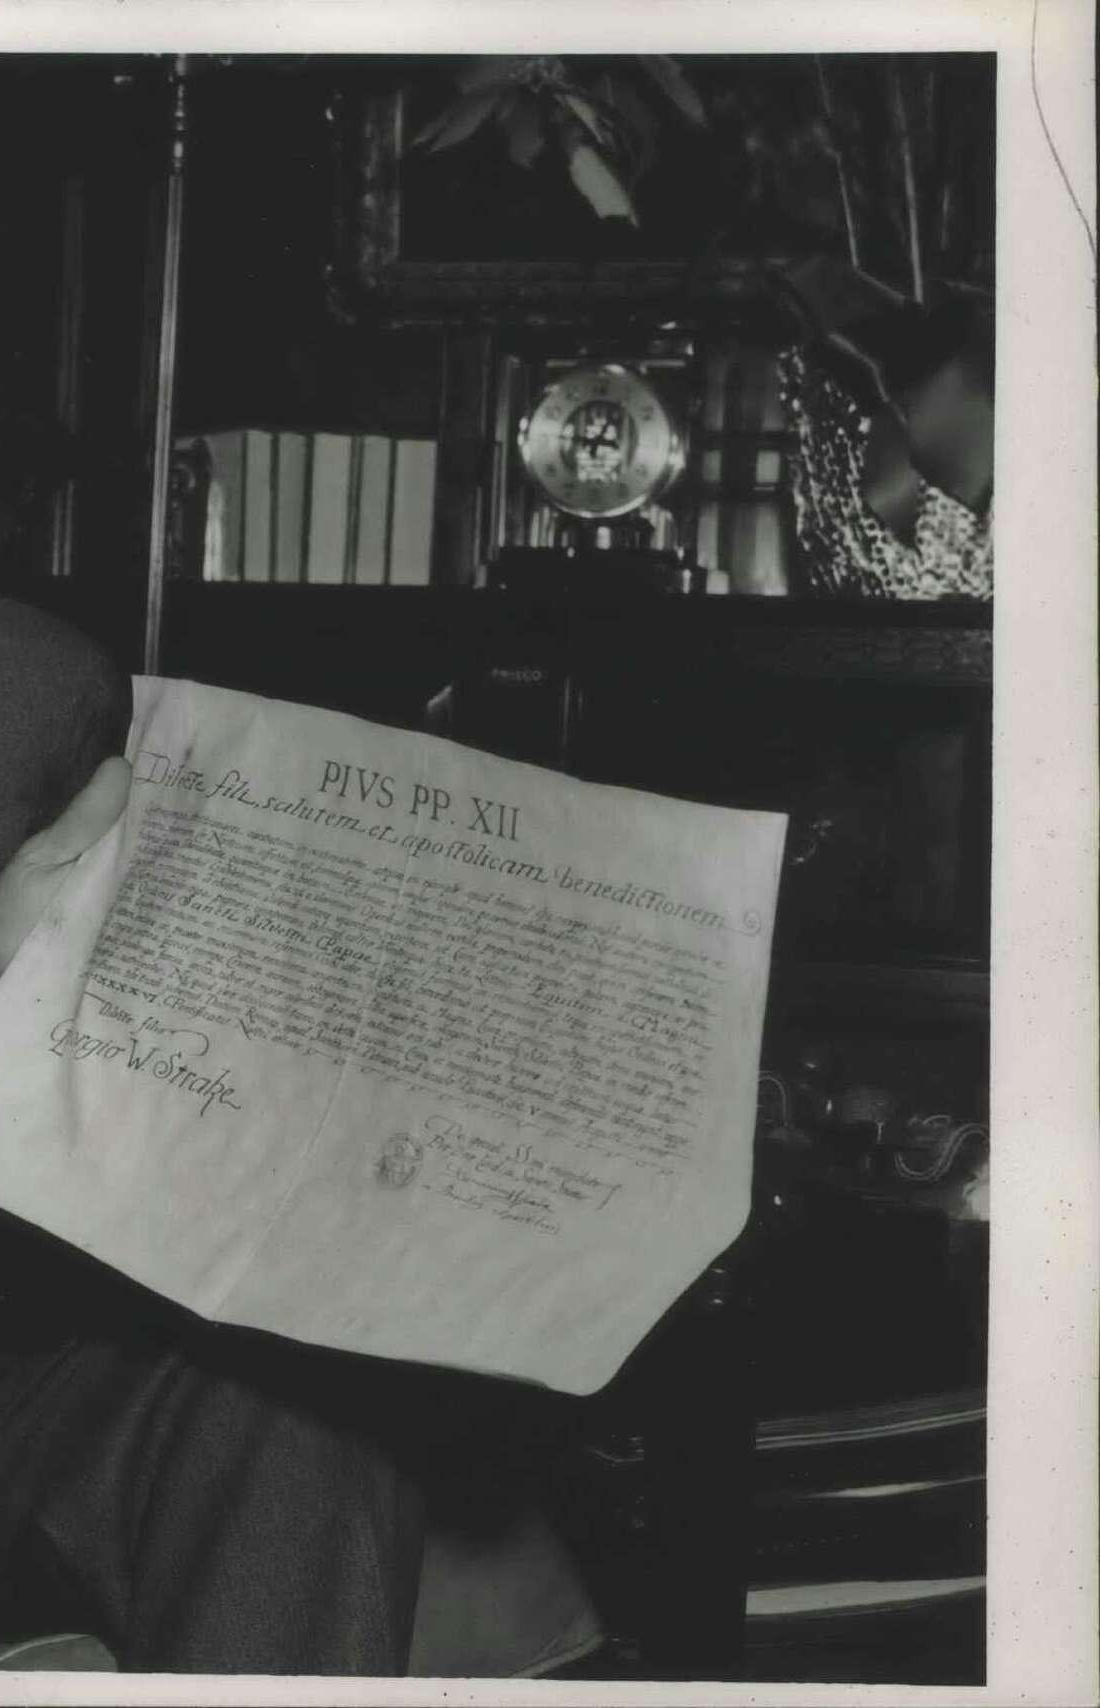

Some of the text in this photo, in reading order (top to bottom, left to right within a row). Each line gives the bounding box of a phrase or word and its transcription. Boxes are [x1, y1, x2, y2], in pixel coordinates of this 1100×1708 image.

[318, 760, 521, 842] PIVS PP. XII
